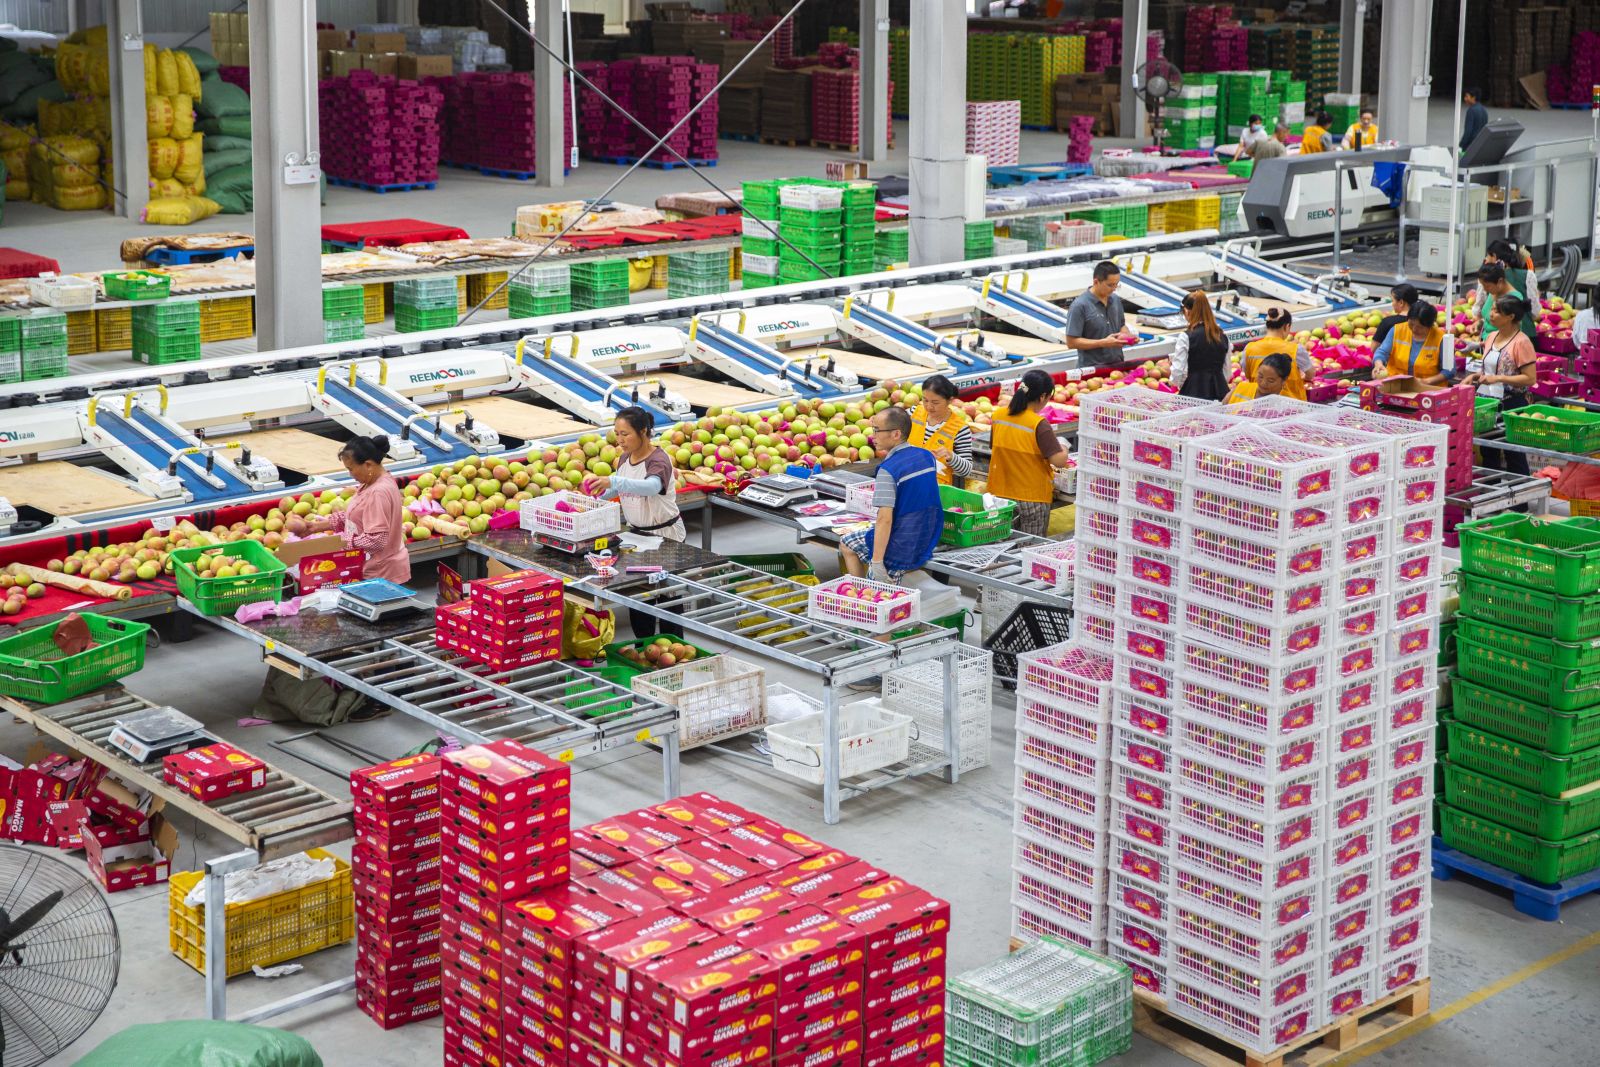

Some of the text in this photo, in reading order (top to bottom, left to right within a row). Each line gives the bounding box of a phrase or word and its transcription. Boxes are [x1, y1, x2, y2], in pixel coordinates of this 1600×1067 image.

[1308, 207, 1344, 220] REEMON
[758, 320, 800, 333] REEMOON
[592, 342, 640, 356] REEMOON
[410, 368, 463, 383] REEMOON
[523, 595, 544, 603] MANGO
[524, 615, 544, 623] MANGO
[523, 634, 543, 643] MANGO
[521, 654, 541, 662] MANGO
[411, 786, 438, 800] MANGO
[459, 781, 480, 796] MANGO
[12, 799, 23, 832] MANGO
[414, 811, 441, 824] MANGO
[459, 810, 480, 825] MANGO
[414, 836, 441, 848] MANGO
[735, 828, 771, 846] MANGO
[459, 839, 480, 854] MANGO
[459, 868, 480, 883] MANGO
[707, 858, 744, 877] MANGO
[415, 884, 441, 896] MANGO
[791, 874, 832, 892] MANGO
[729, 886, 771, 904] MANGO
[459, 896, 480, 912] MANGO
[413, 909, 441, 920] MANGO
[848, 903, 892, 922] MANGO
[637, 917, 681, 936] MANGO
[785, 915, 829, 933] MANGO
[417, 933, 441, 944] MANG
[460, 926, 482, 942] MANGO
[522, 933, 544, 948] MANGO
[894, 929, 923, 945] MANGO
[413, 957, 441, 969] MANGO
[459, 955, 480, 971] MANGO
[697, 946, 742, 966] MANGO
[522, 962, 544, 978] MANGO
[808, 960, 838, 977] MANGO
[892, 957, 921, 974] MANGO
[413, 981, 441, 992] MANGO
[460, 983, 480, 999] MANGO
[890, 986, 919, 1003] MANGO
[522, 991, 544, 1007] MANGO
[718, 993, 751, 1012] MANGO
[804, 991, 834, 1008] MANGO
[412, 1004, 440, 1016] MANGO
[460, 1011, 481, 1028] MANGO
[891, 1016, 919, 1033] MANGO
[522, 1021, 544, 1038] MANGO
[713, 1025, 746, 1043] MANGO
[804, 1021, 834, 1038] MANGO
[462, 1041, 483, 1057] MANGO
[890, 1045, 918, 1061] MANGO
[523, 1049, 544, 1067] MANGO
[804, 1051, 834, 1067] MANGO
